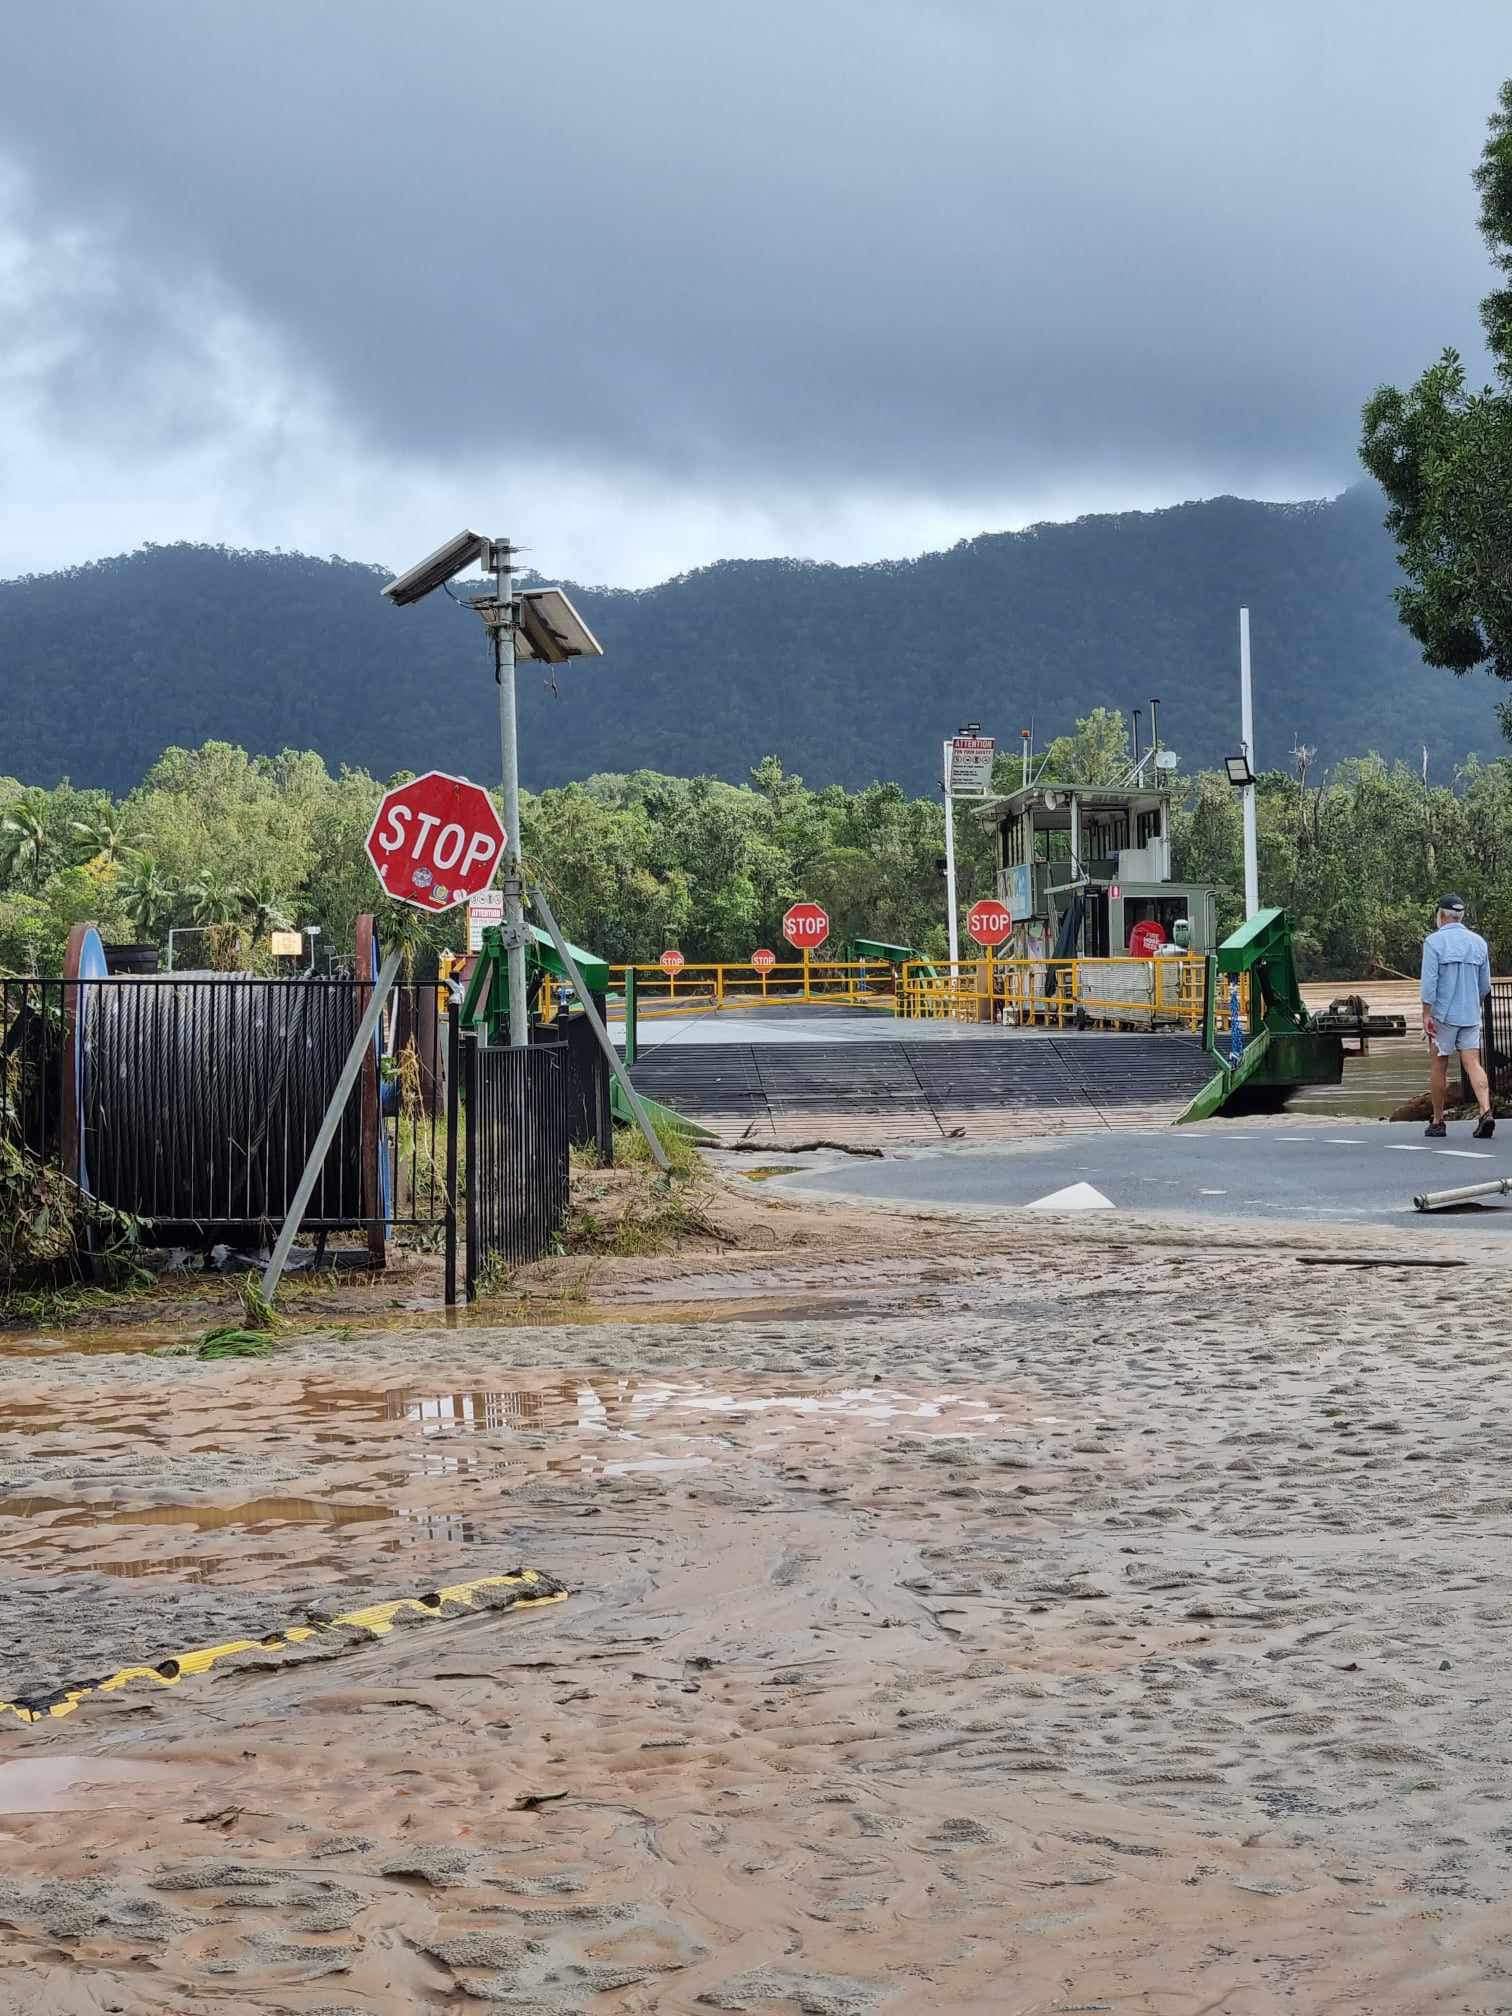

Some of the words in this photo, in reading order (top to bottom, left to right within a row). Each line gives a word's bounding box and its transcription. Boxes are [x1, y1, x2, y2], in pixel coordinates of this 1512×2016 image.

[954, 740, 992, 748] ATTENTION
[379, 805, 496, 876] STOP
[788, 917, 826, 934] STOP
[971, 914, 1009, 931] STOP
[662, 957, 682, 966] STOP
[753, 956, 774, 966] STOP
